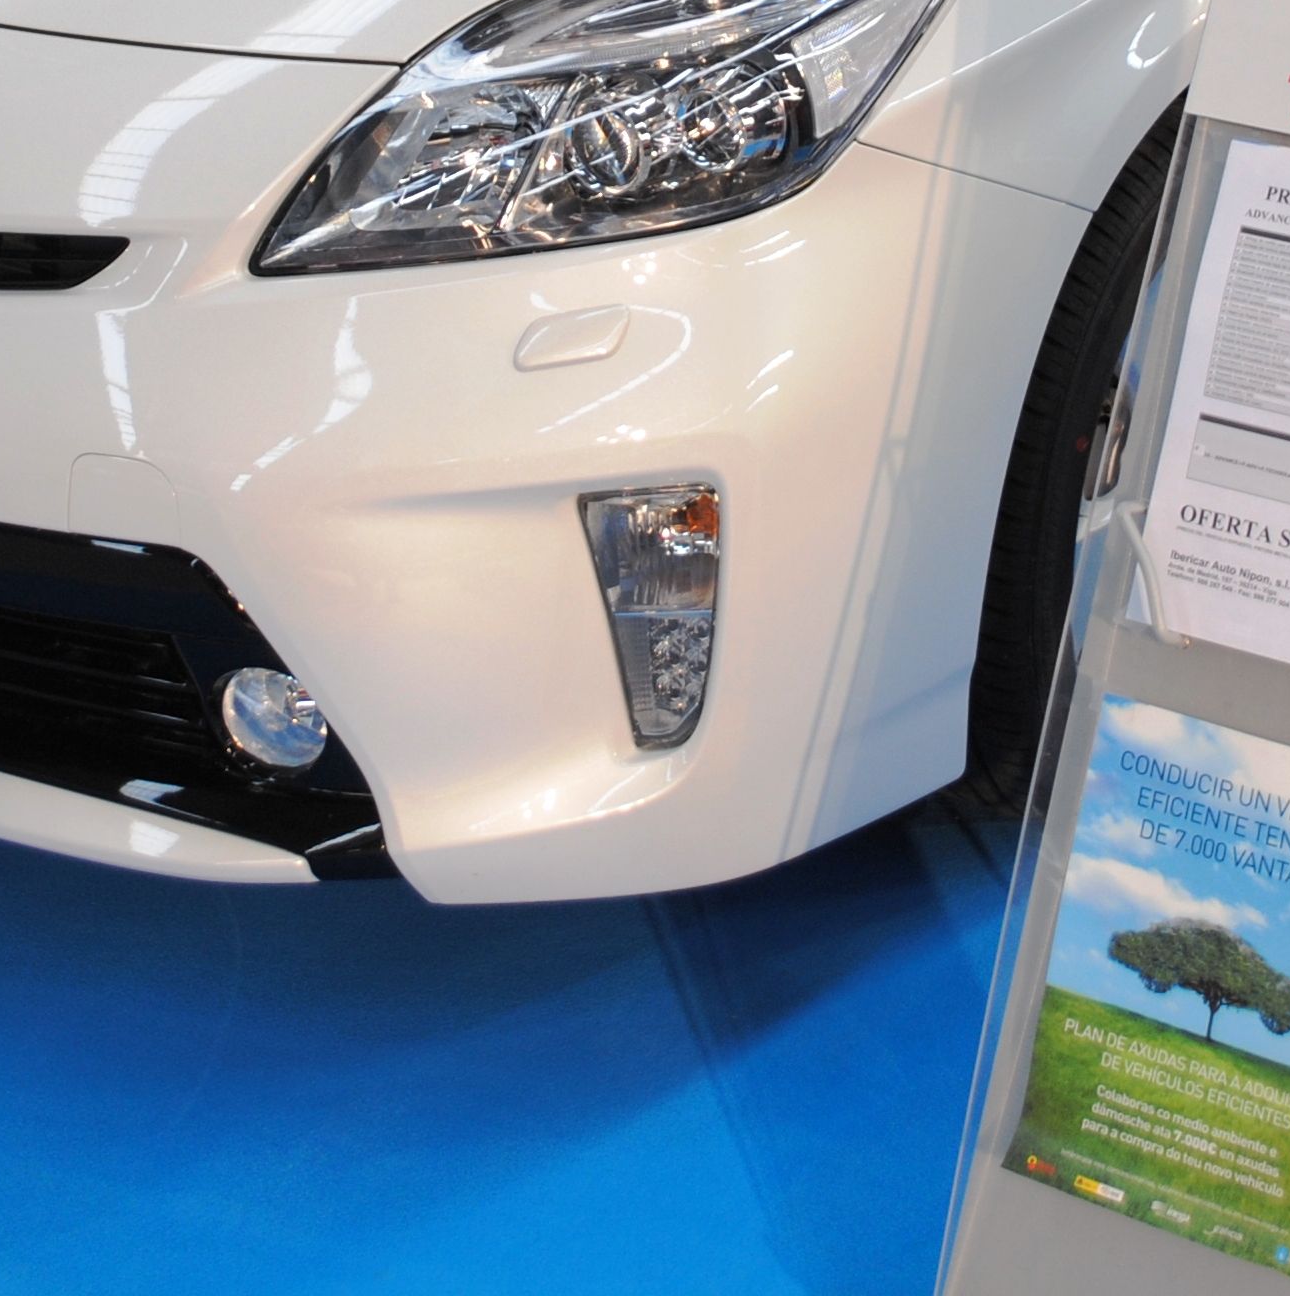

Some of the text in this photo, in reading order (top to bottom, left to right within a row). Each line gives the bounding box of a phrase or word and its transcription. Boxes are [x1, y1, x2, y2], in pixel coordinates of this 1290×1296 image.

[1178, 502, 1273, 544] OFERTA
[1169, 549, 1209, 569] Ibericar
[1210, 560, 1237, 576] Auto
[1118, 749, 1234, 802] CONDUCIR
[1237, 784, 1271, 813] UN
[1136, 786, 1249, 838] EFICIENTE
[1139, 818, 1169, 846] DE
[1171, 828, 1228, 863] 7.000
[1064, 1017, 1104, 1044] PLAN
[1105, 1031, 1126, 1052] DE
[1127, 1038, 1187, 1072] AXUDAS
[1188, 1059, 1228, 1086] PARA
[1228, 1072, 1242, 1091] A
[1100, 1051, 1122, 1072] DE
[1122, 1056, 1205, 1100] VEHÍCULOS
[1095, 1083, 1277, 1158] Colaboras co medio ambiente e
[1081, 1116, 1284, 1199] para a compra do teu novo vehículo
[1218, 1148, 1234, 1162] en
[1236, 1152, 1280, 1178] axudas
